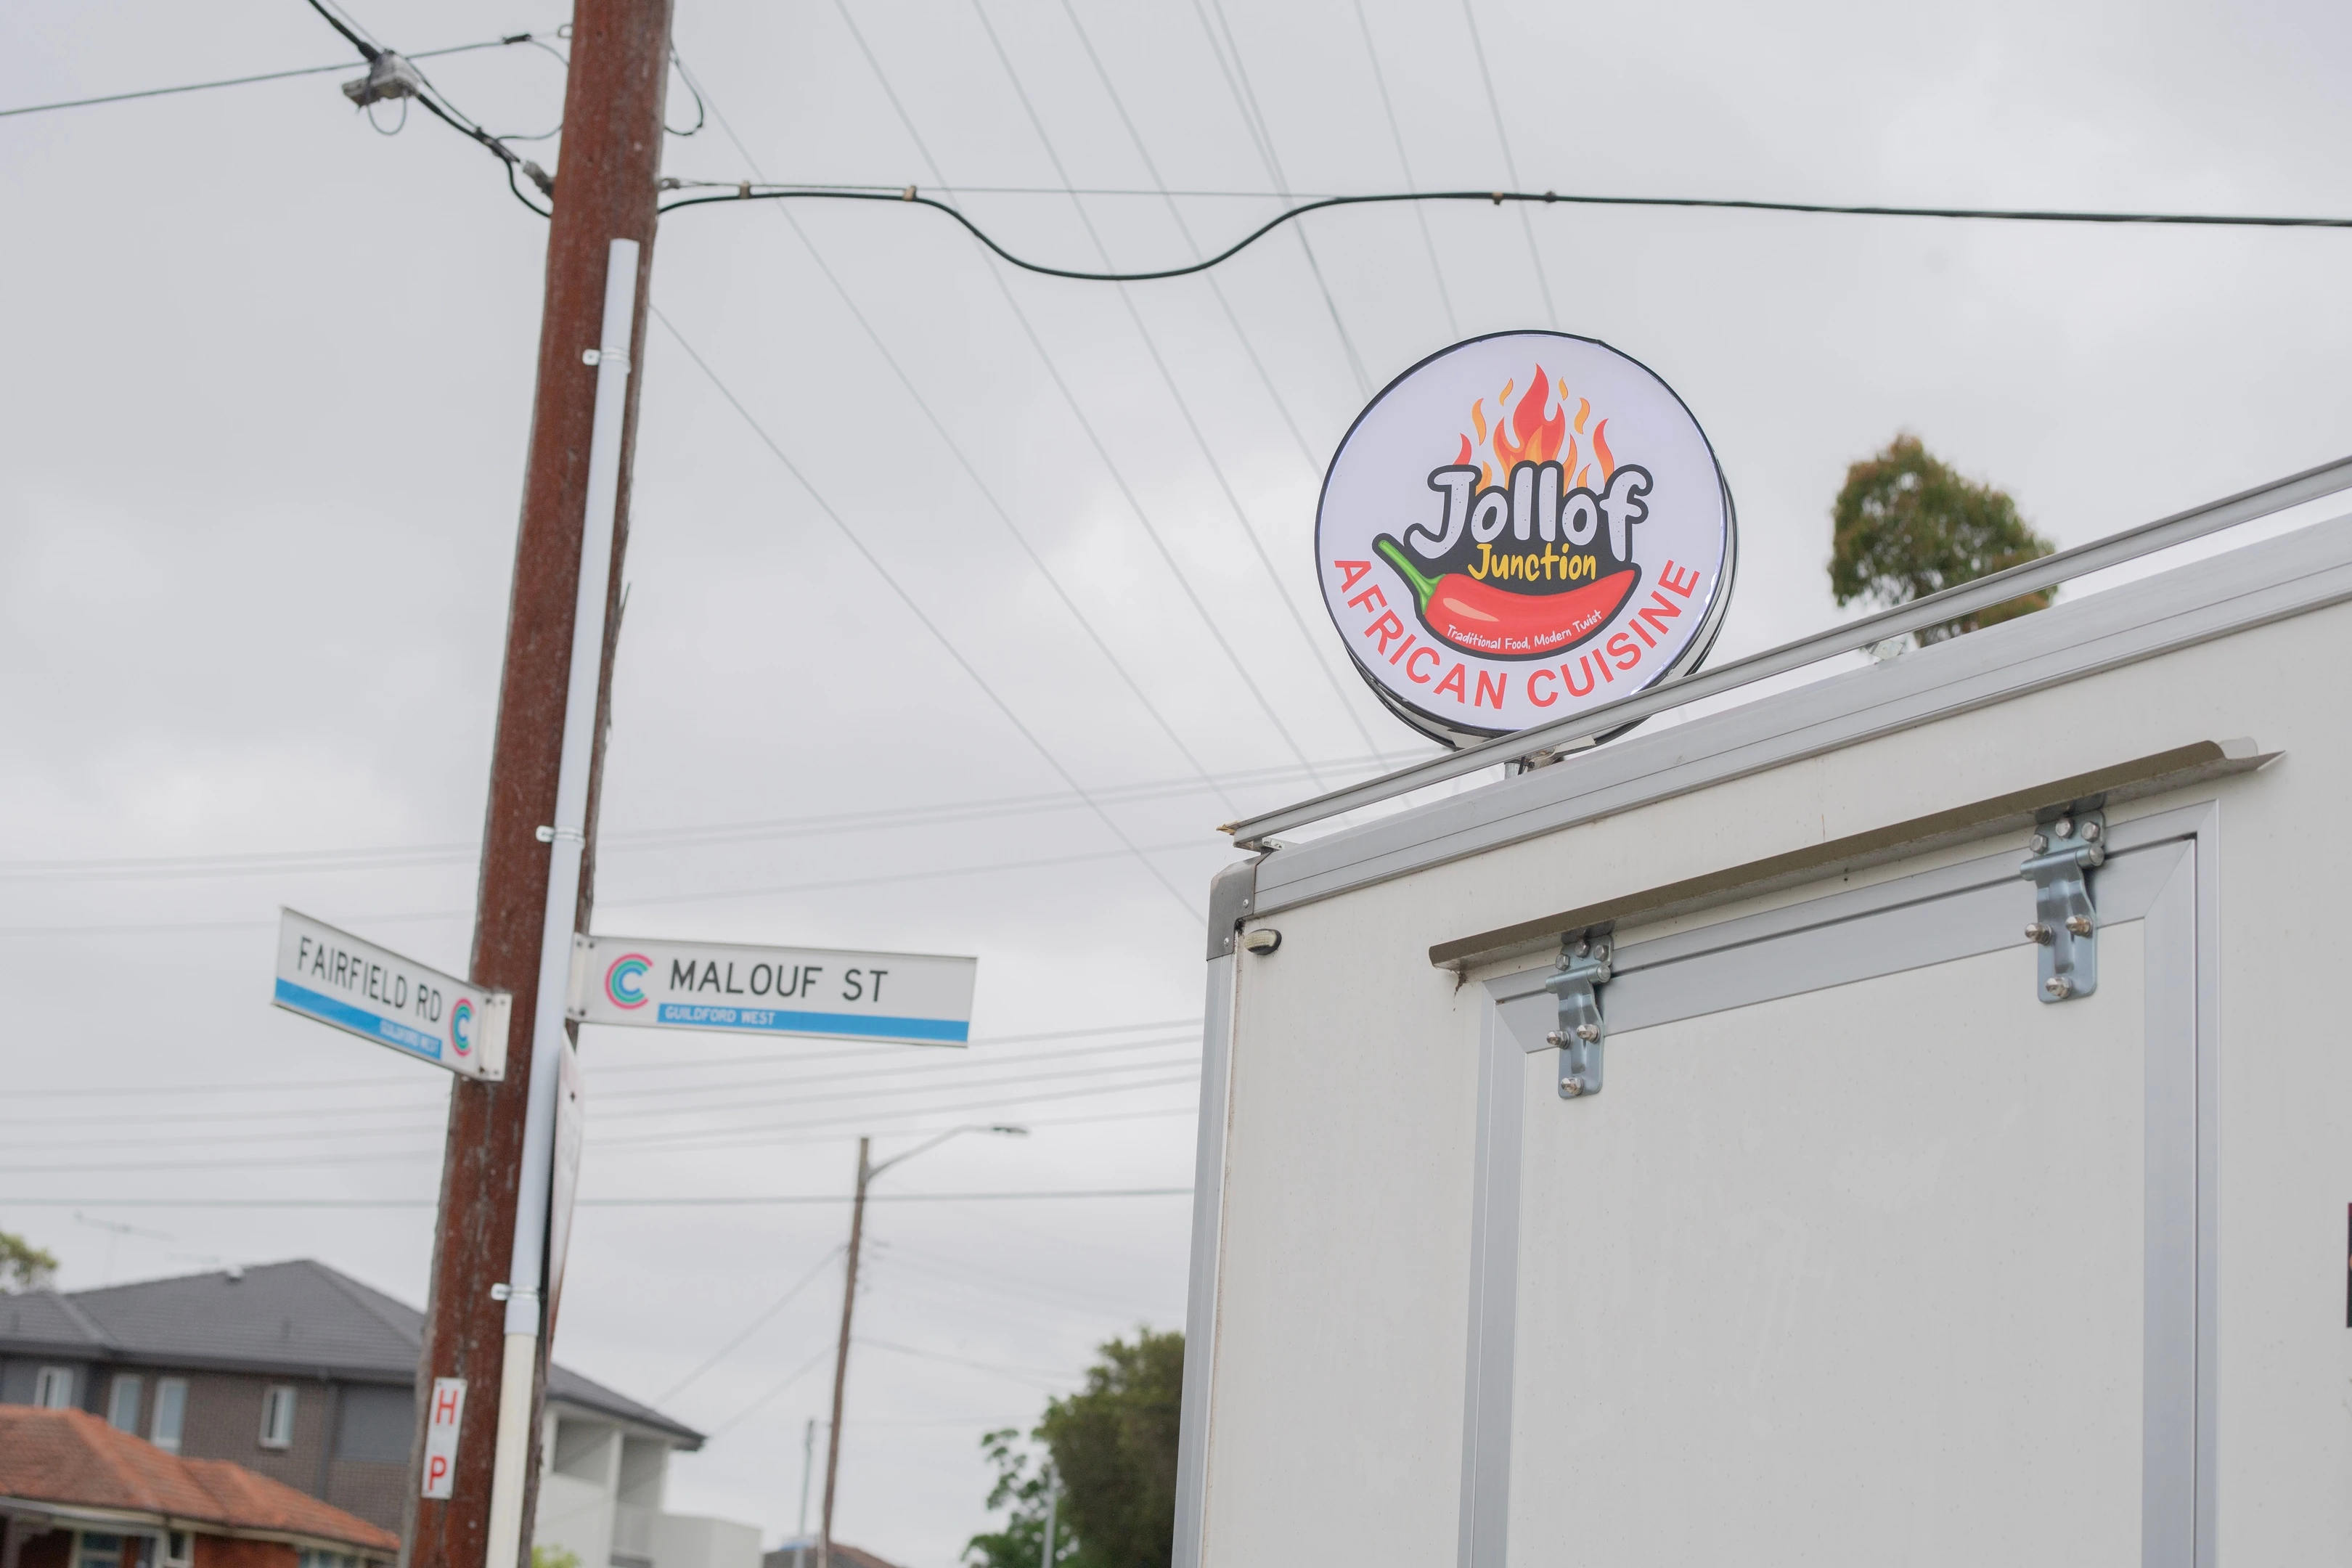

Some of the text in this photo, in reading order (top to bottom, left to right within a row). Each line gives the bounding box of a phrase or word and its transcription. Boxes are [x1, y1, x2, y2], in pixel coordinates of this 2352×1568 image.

[1410, 465, 1646, 562] Jollof
[1467, 543, 1596, 581] Junction
[1334, 559, 1701, 709] AFRICAN CUISINE
[1447, 609, 1602, 650] Traditional Food, Modern Twist
[298, 936, 442, 1022] FAIRFIELD RD
[670, 959, 889, 1003] MALOUF ST
[665, 1005, 776, 1025] GUILDFORD WEST
